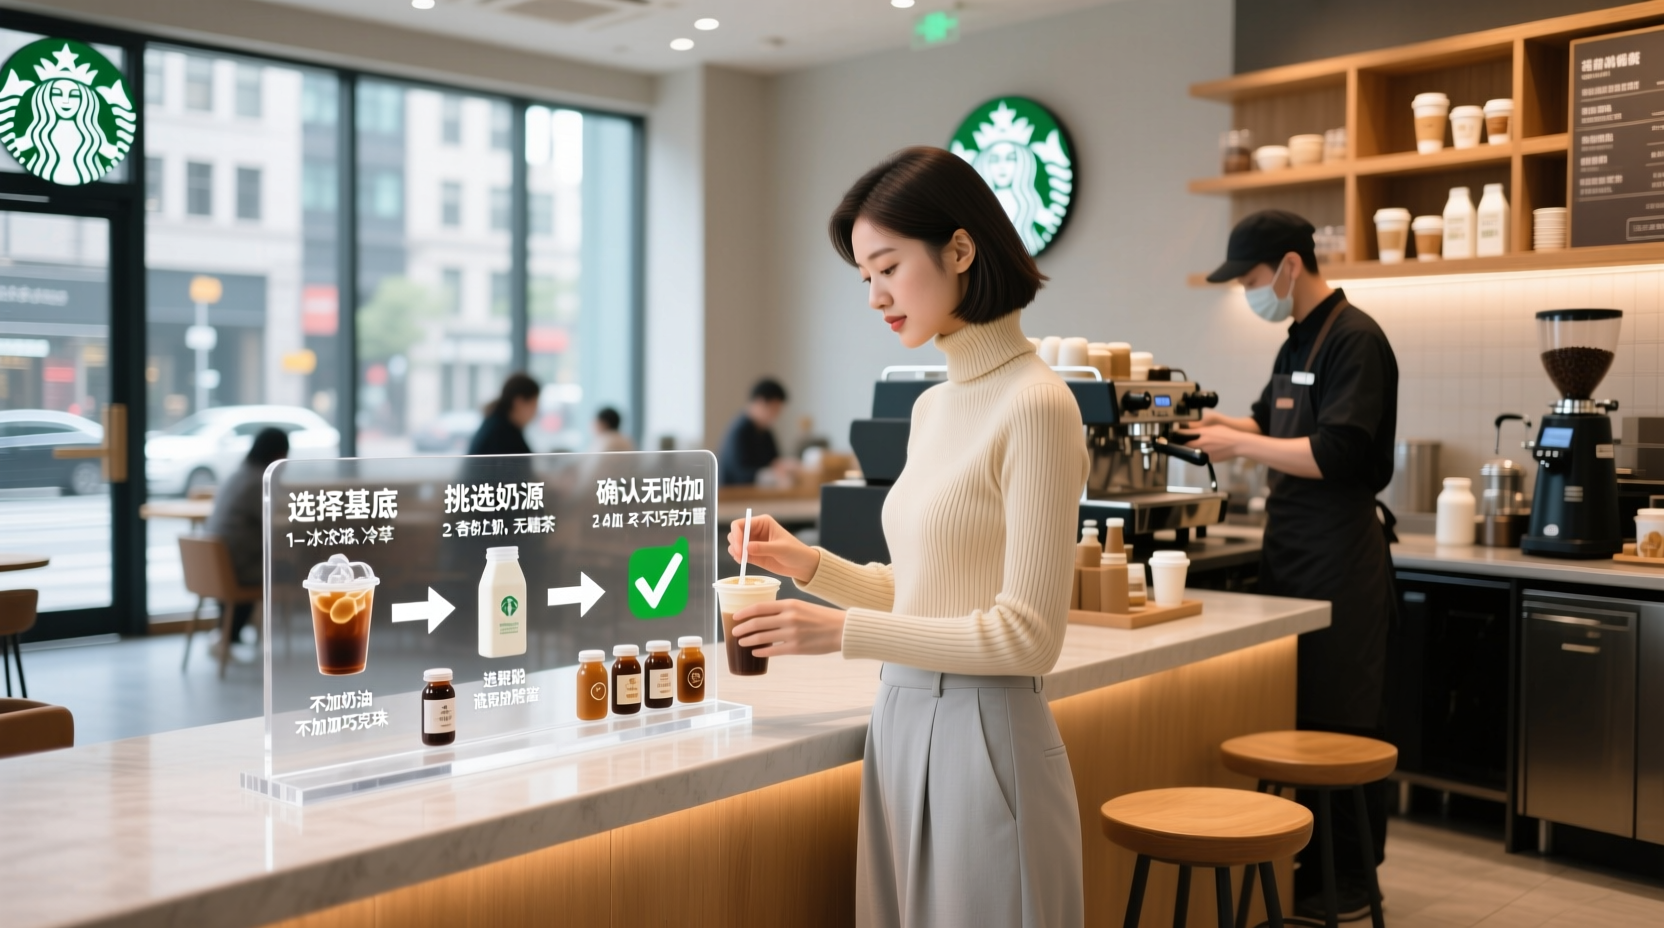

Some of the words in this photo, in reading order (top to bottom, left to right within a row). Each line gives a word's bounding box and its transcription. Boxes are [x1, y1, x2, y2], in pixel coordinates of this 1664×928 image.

[288, 487, 398, 522] 选择基底
[444, 481, 545, 514] 挑选奶源
[596, 475, 704, 506] 确认无附加
[309, 688, 373, 714] 不加奶油
